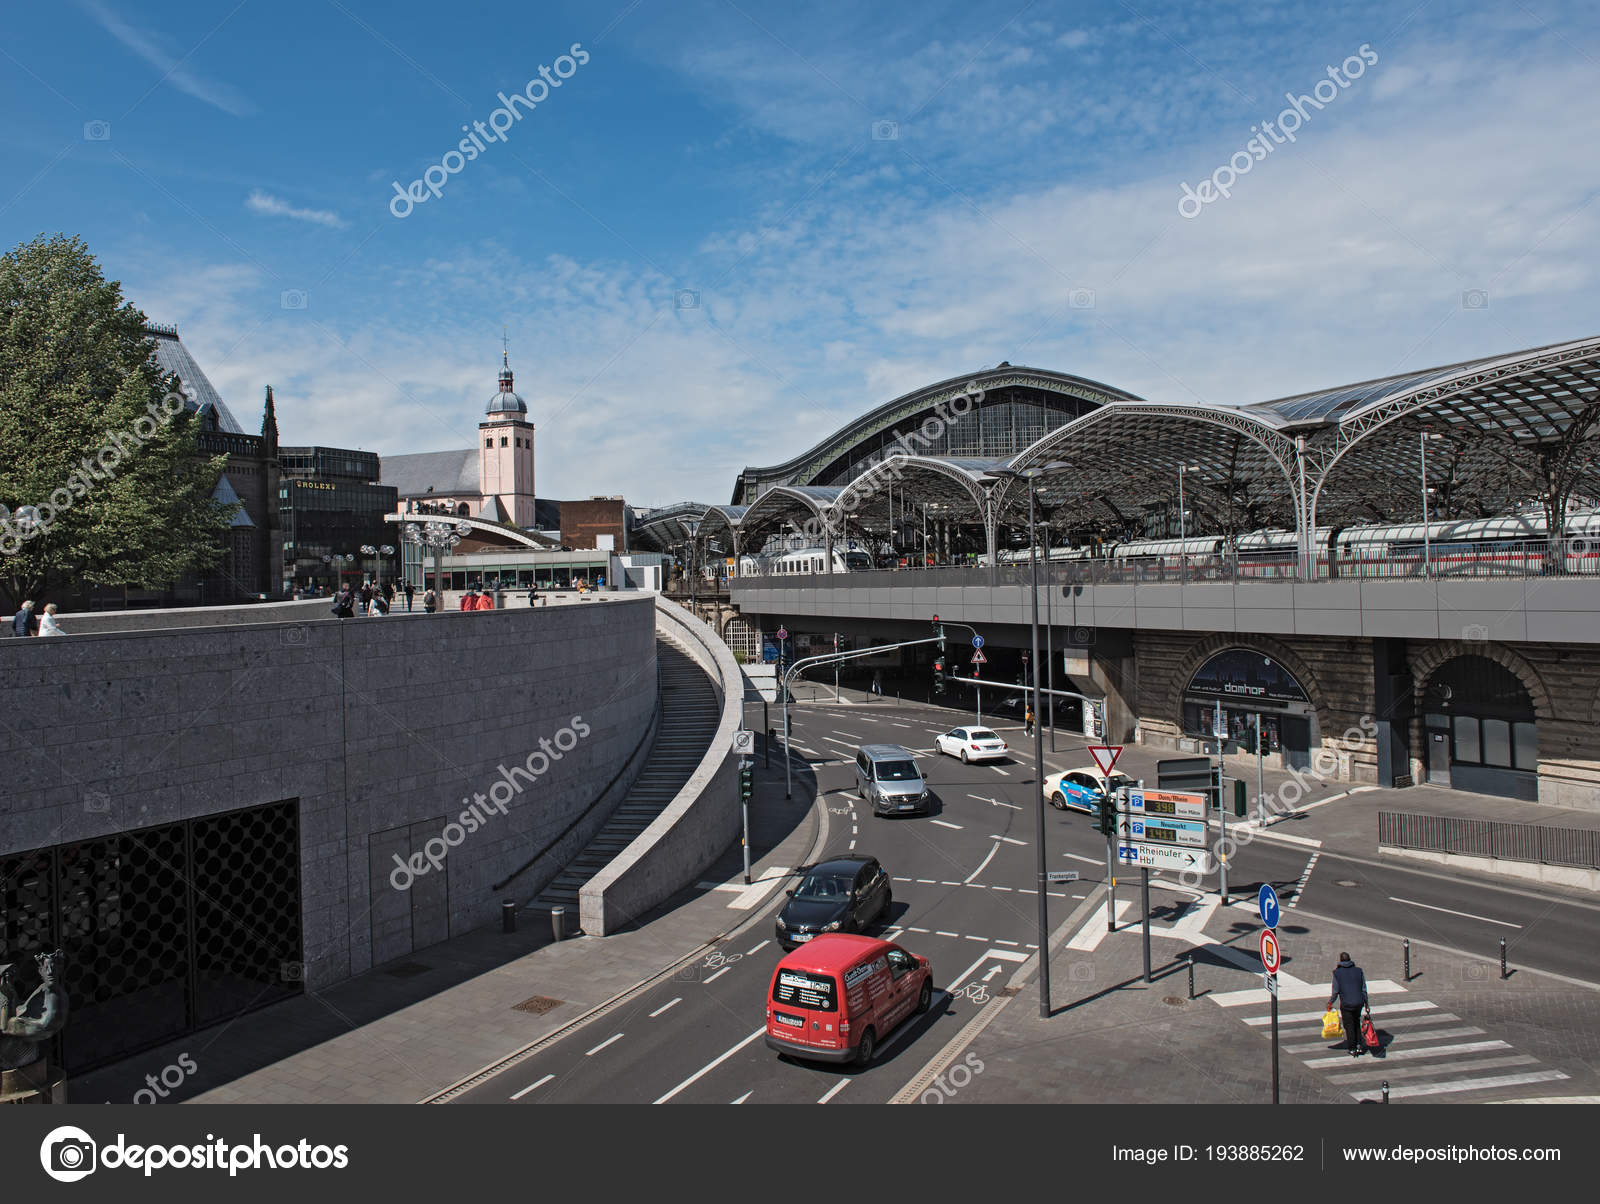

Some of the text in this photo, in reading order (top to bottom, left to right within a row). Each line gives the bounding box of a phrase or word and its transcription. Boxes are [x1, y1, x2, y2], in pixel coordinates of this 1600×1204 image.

[302, 481, 330, 489] ROLEX
[1155, 802, 1174, 813] 398
[1160, 821, 1186, 830] Neumarkt
[1139, 846, 1182, 858] Rheinufer
[1140, 856, 1154, 864] Hbf
